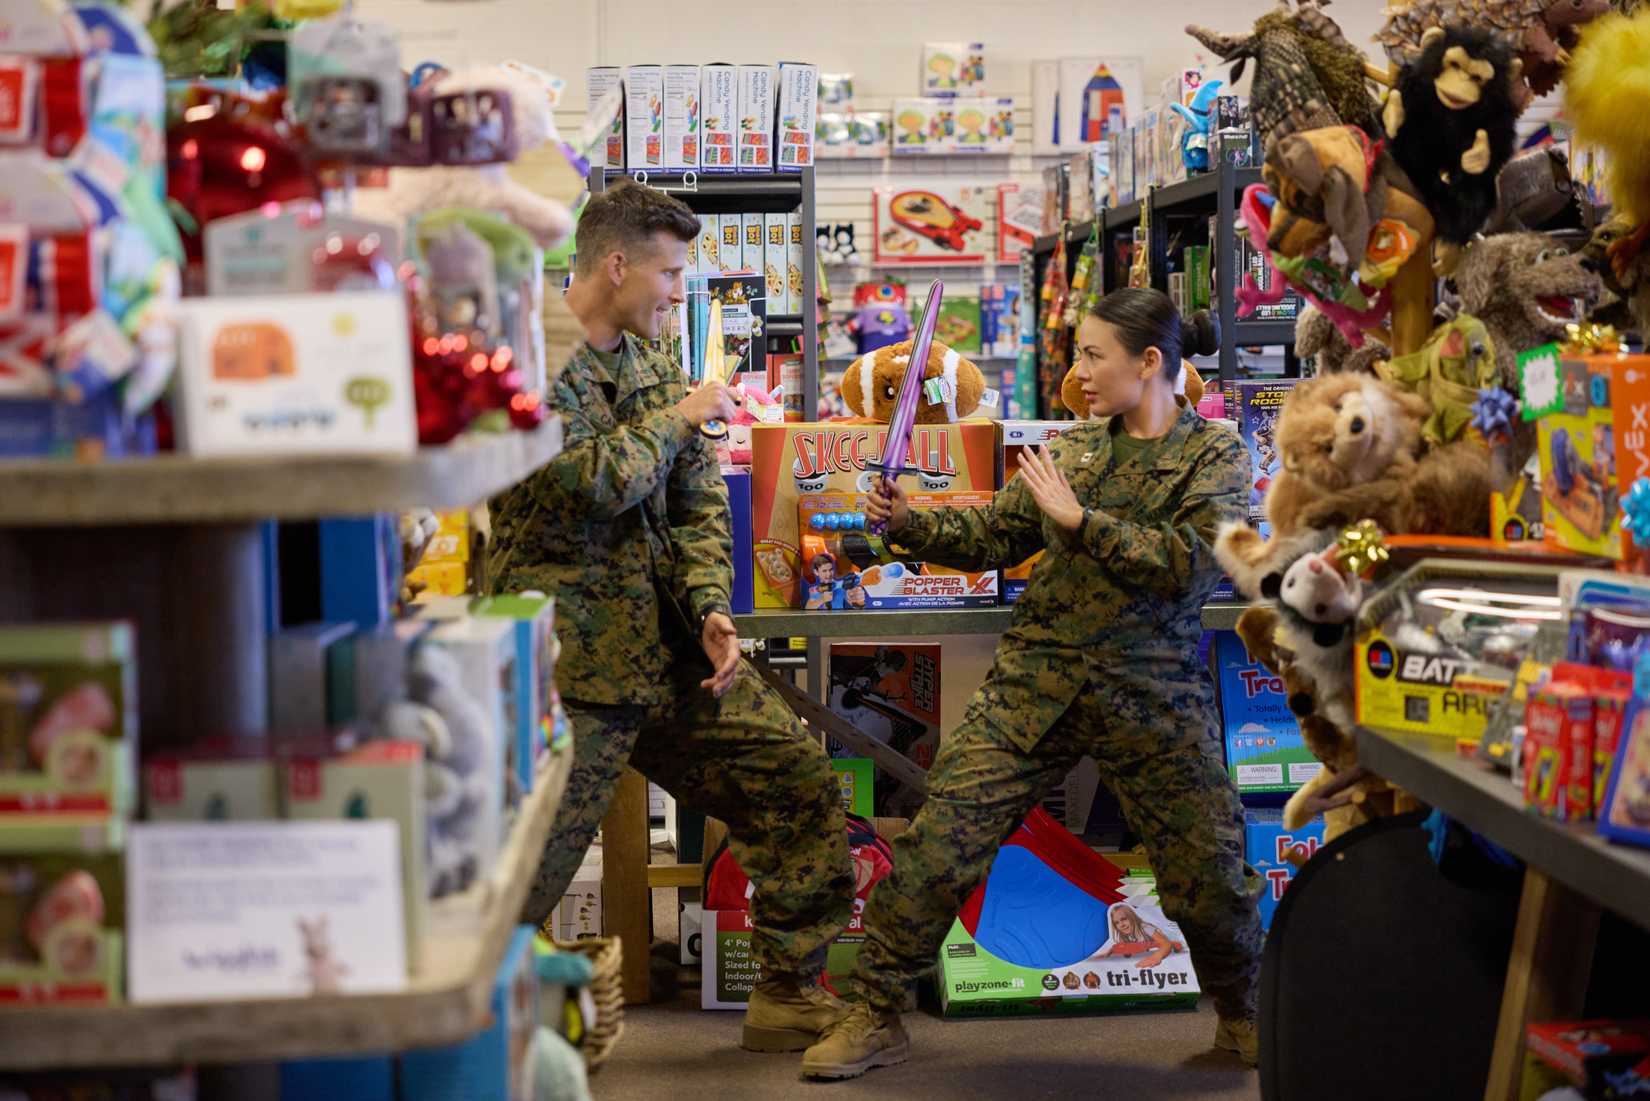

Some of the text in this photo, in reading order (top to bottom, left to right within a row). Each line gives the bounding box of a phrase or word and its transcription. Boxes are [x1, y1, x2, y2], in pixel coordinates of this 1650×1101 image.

[1255, 391, 1284, 399] STO
[793, 430, 957, 480] SKEE-ALL
[798, 482, 824, 491] 100
[922, 481, 949, 489] 100
[904, 577, 961, 586] POPPER
[903, 586, 965, 595] BLASTER
[725, 961, 749, 969] Sized
[1106, 968, 1188, 990] tri-flyer
